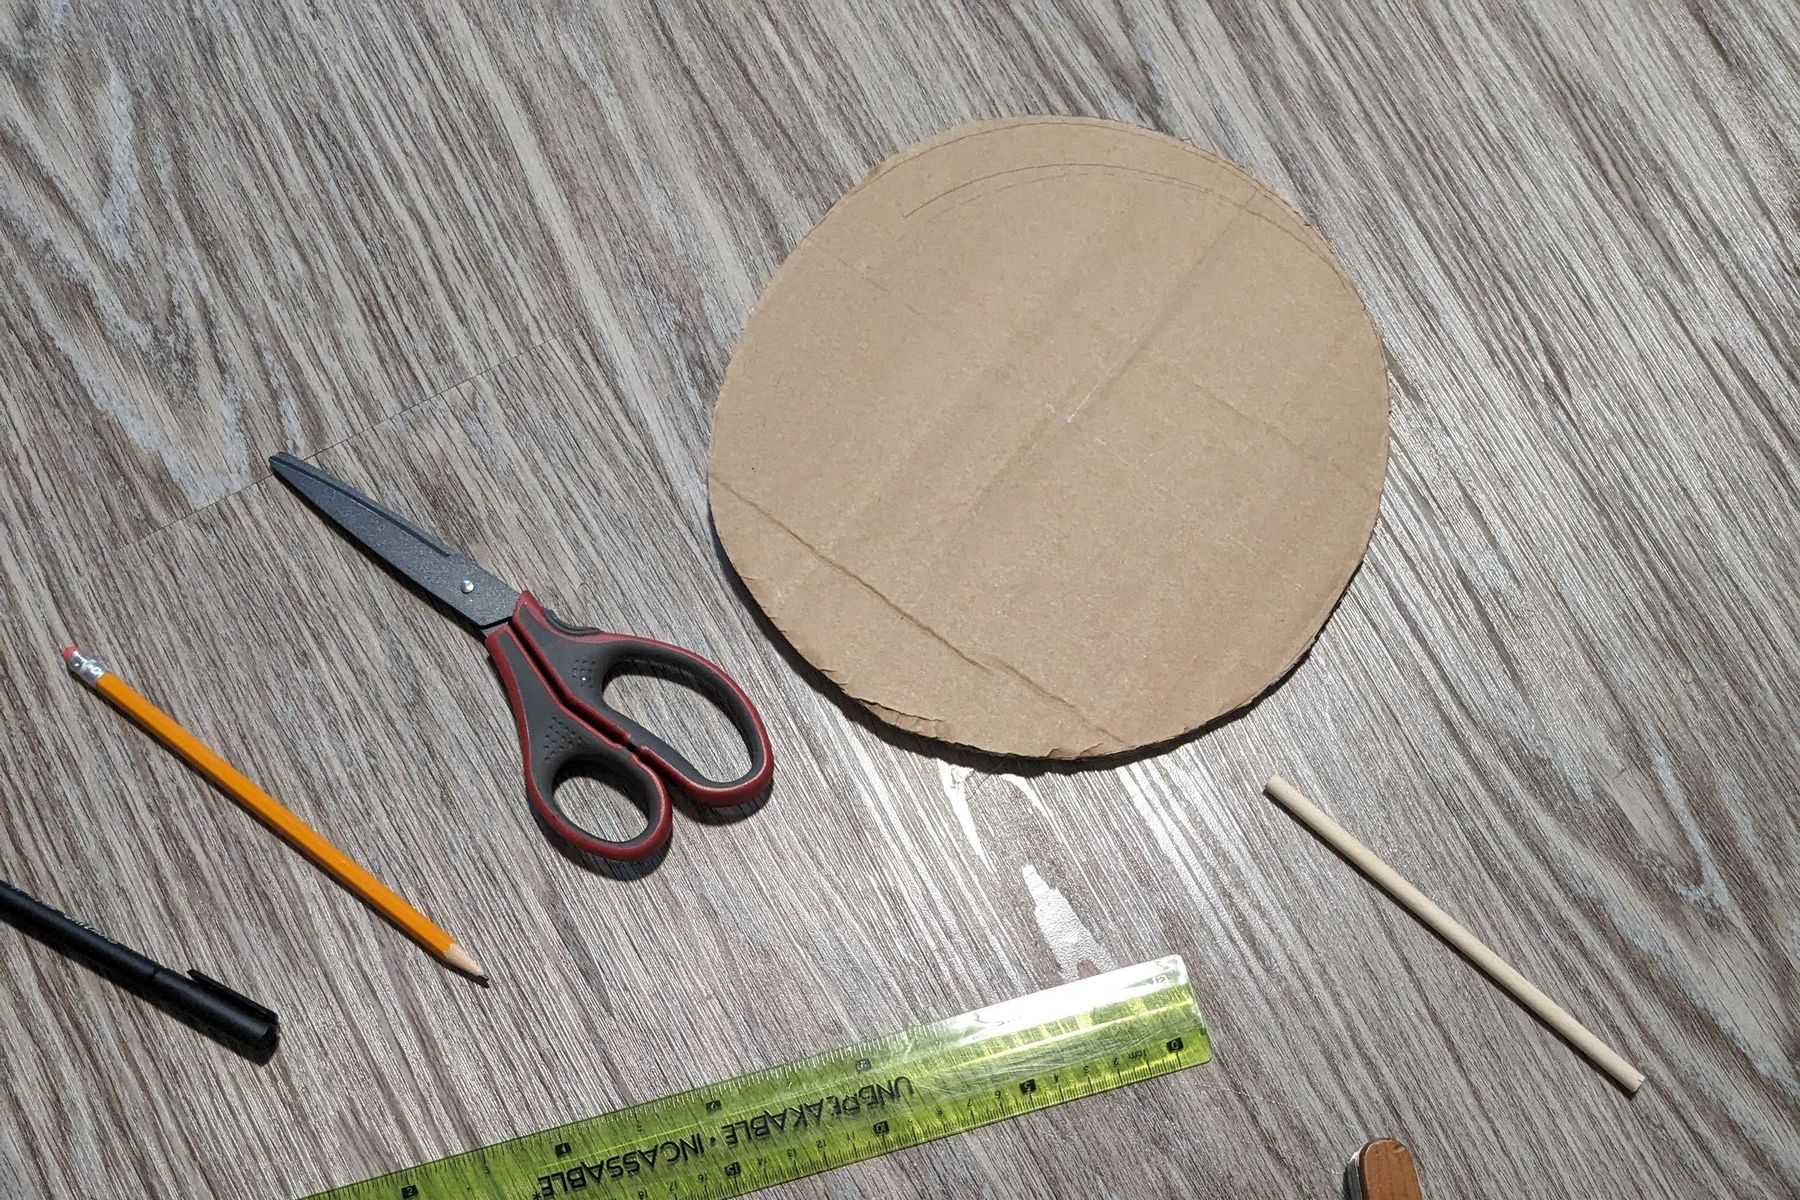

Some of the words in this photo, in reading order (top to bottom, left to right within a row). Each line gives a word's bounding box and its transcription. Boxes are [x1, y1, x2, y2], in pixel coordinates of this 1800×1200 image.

[1170, 1039, 1179, 1049] 0
[1111, 1056, 1119, 1065] 2
[1082, 1065, 1090, 1074] 3
[1023, 1082, 1033, 1093] 5
[994, 1090, 1002, 1099] 6
[965, 1098, 973, 1107] 7
[721, 1076, 915, 1147] UNBREAKABLE
[815, 1138, 827, 1148] 12
[725, 1163, 740, 1176] 15
[696, 1172, 708, 1183] 16
[406, 1186, 414, 1196] 2
[668, 1181, 678, 1191] 17
[637, 1189, 647, 1199] 18
